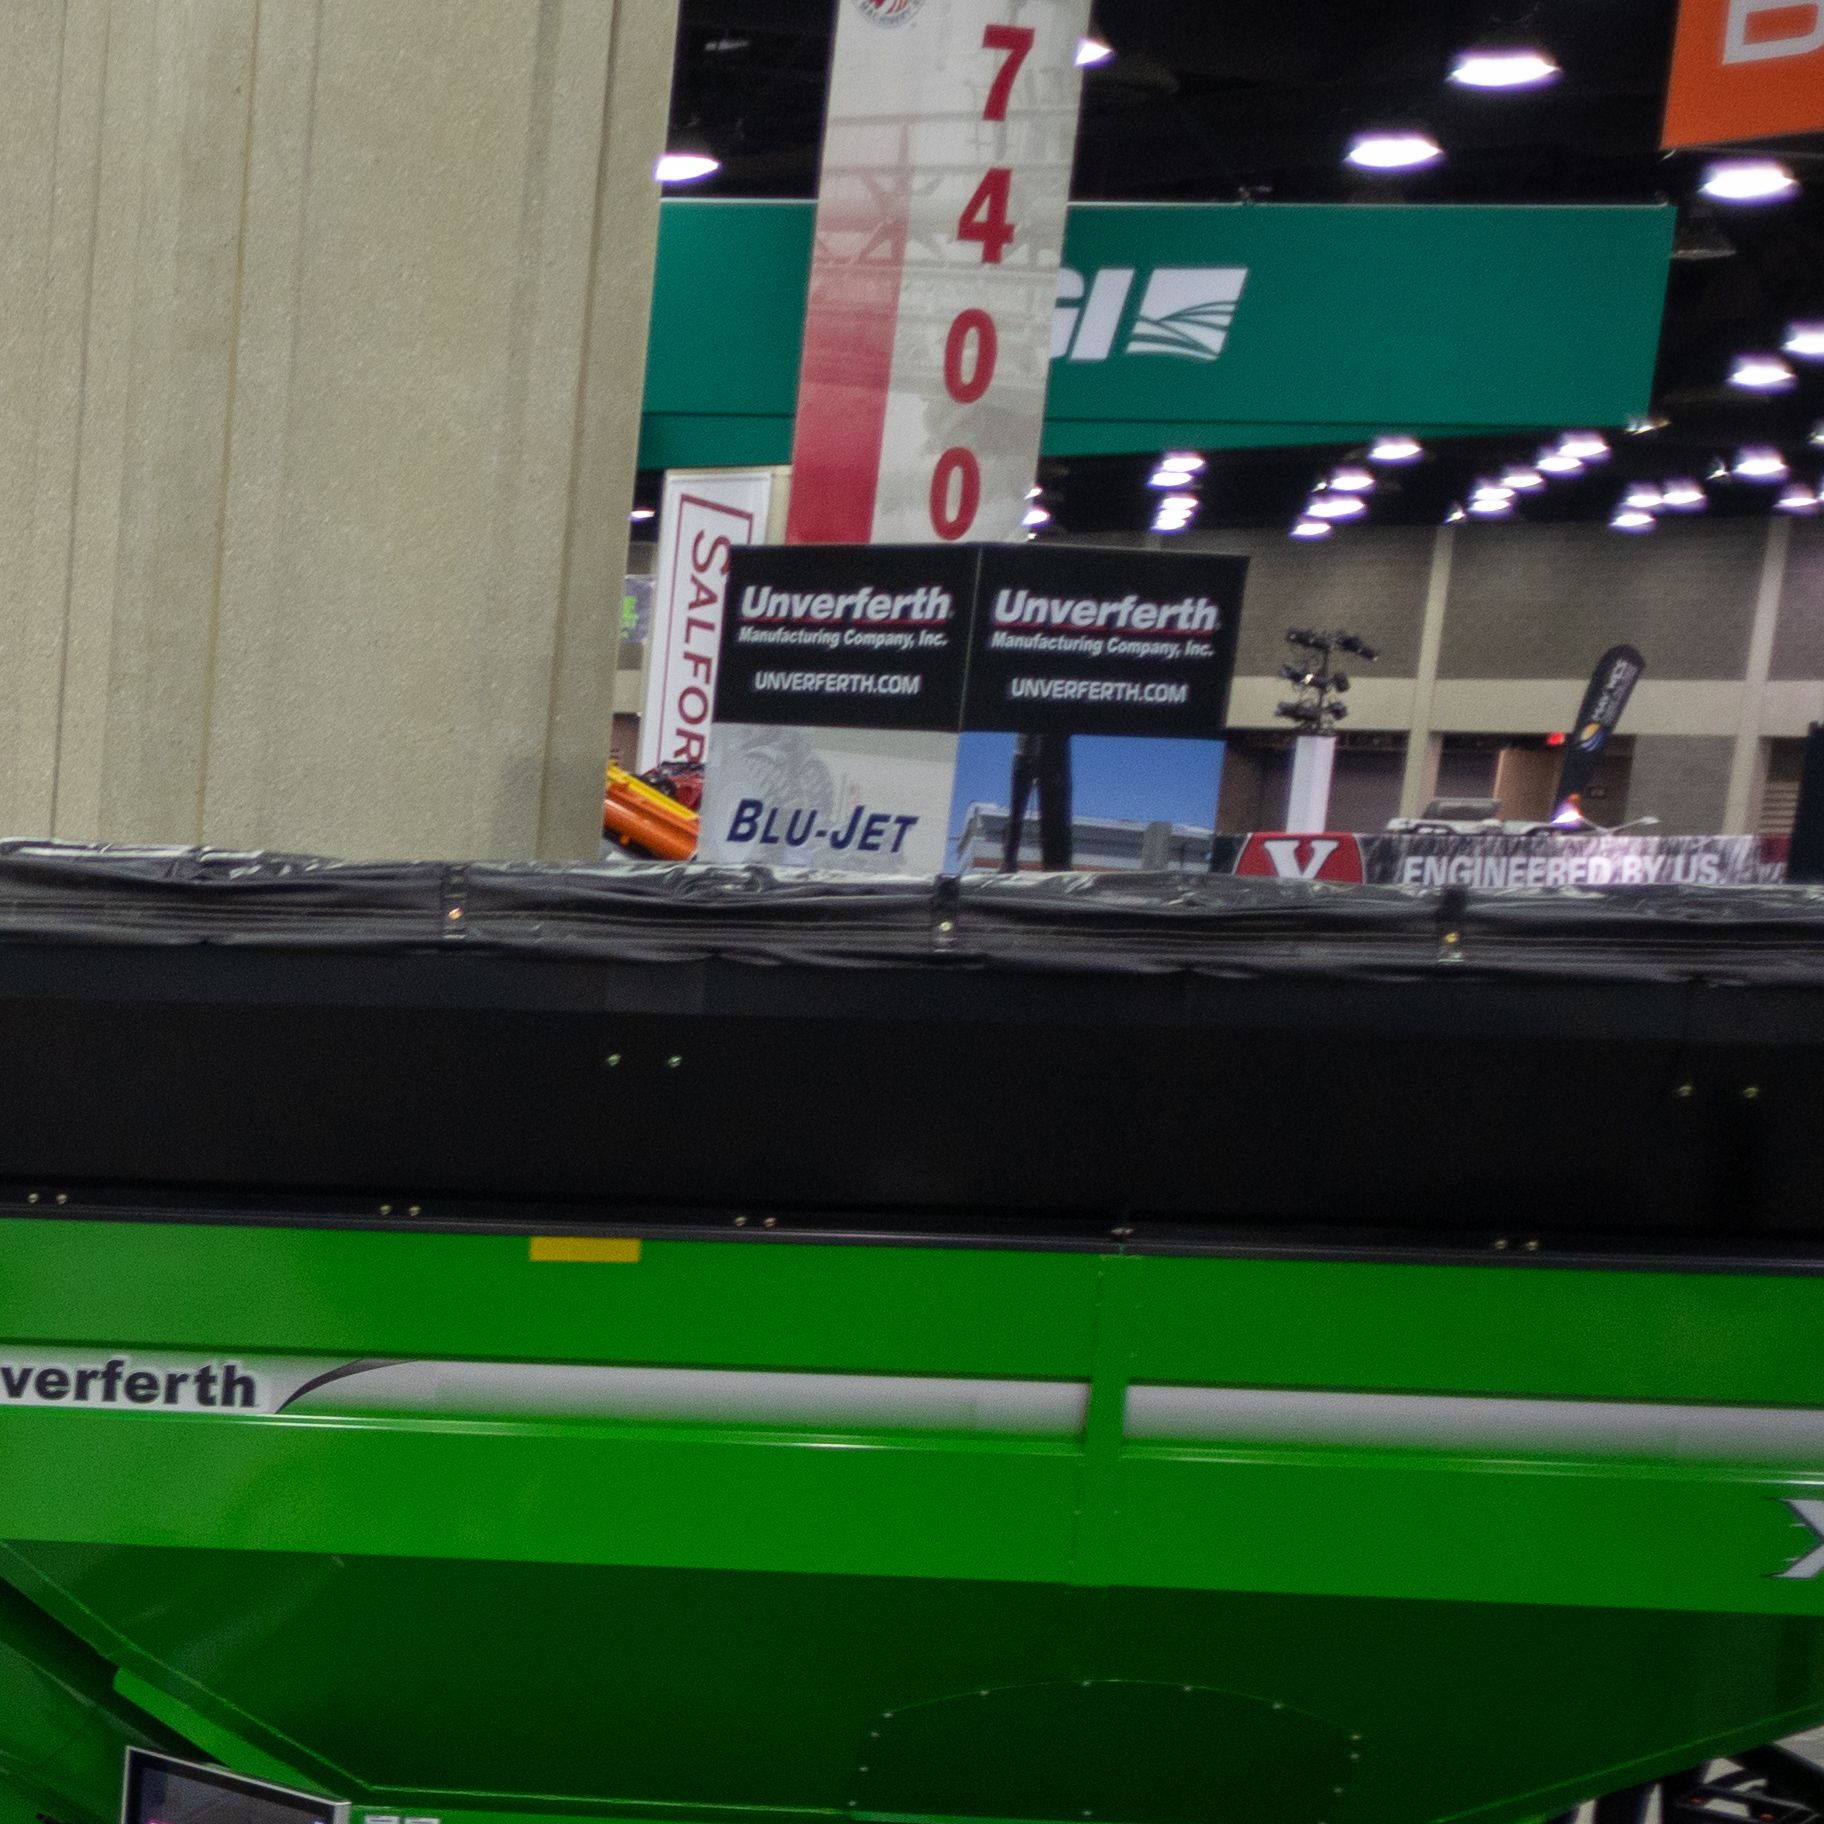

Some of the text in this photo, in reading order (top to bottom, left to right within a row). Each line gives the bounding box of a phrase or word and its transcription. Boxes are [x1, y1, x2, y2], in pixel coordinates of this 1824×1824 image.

[740, 585, 953, 622] Unverferth
[994, 589, 1218, 632] Unverferth
[671, 528, 731, 763] SALFOR
[739, 626, 948, 651] Manufacturing Company, Inc.
[990, 630, 1213, 660] Manufacturing Company, Inc.
[754, 670, 922, 696] UNVERFERTH.COM
[1011, 677, 1189, 705] UNVERFERTH.COM
[728, 799, 918, 854] BLU-JET
[1405, 854, 1613, 886] ENGINEERED
[1621, 855, 1665, 886] BY
